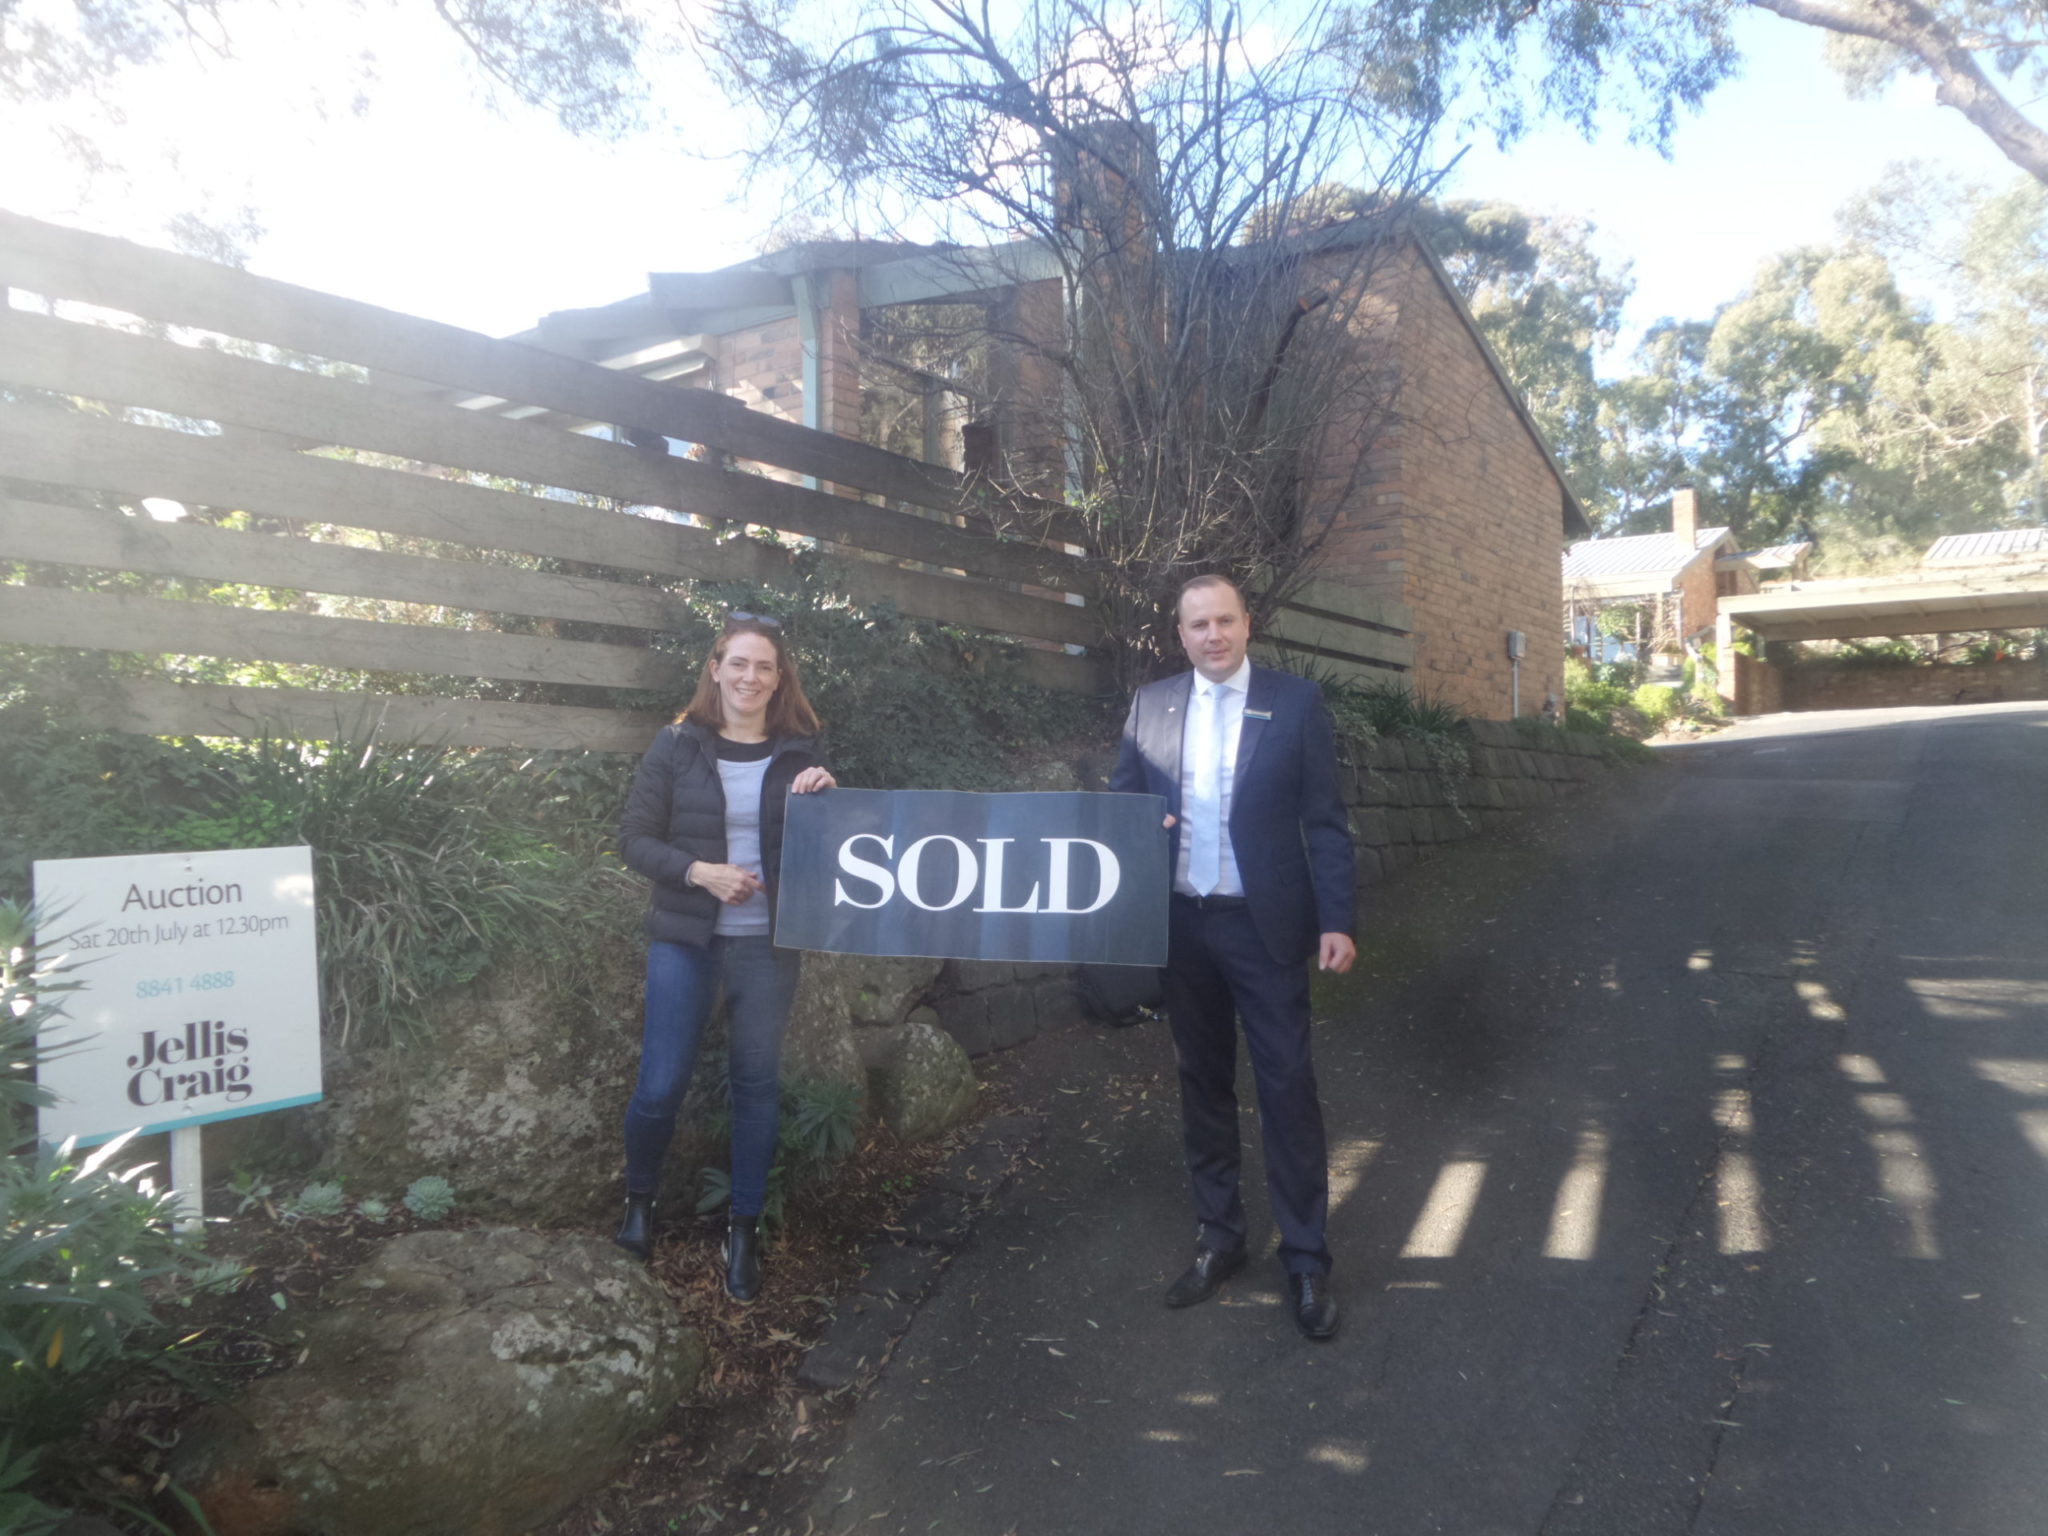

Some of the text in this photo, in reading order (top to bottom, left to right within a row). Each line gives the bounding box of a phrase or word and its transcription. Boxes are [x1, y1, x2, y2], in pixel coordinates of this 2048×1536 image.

[834, 833, 1121, 914] SOLD
[121, 878, 243, 912] Auction
[69, 932, 101, 951] Sat
[106, 923, 150, 947] 20th
[154, 921, 188, 945] July
[193, 923, 211, 938] at
[136, 970, 235, 999] 8841 4888
[126, 1020, 249, 1070] Jellis
[126, 1057, 253, 1107] Craig
